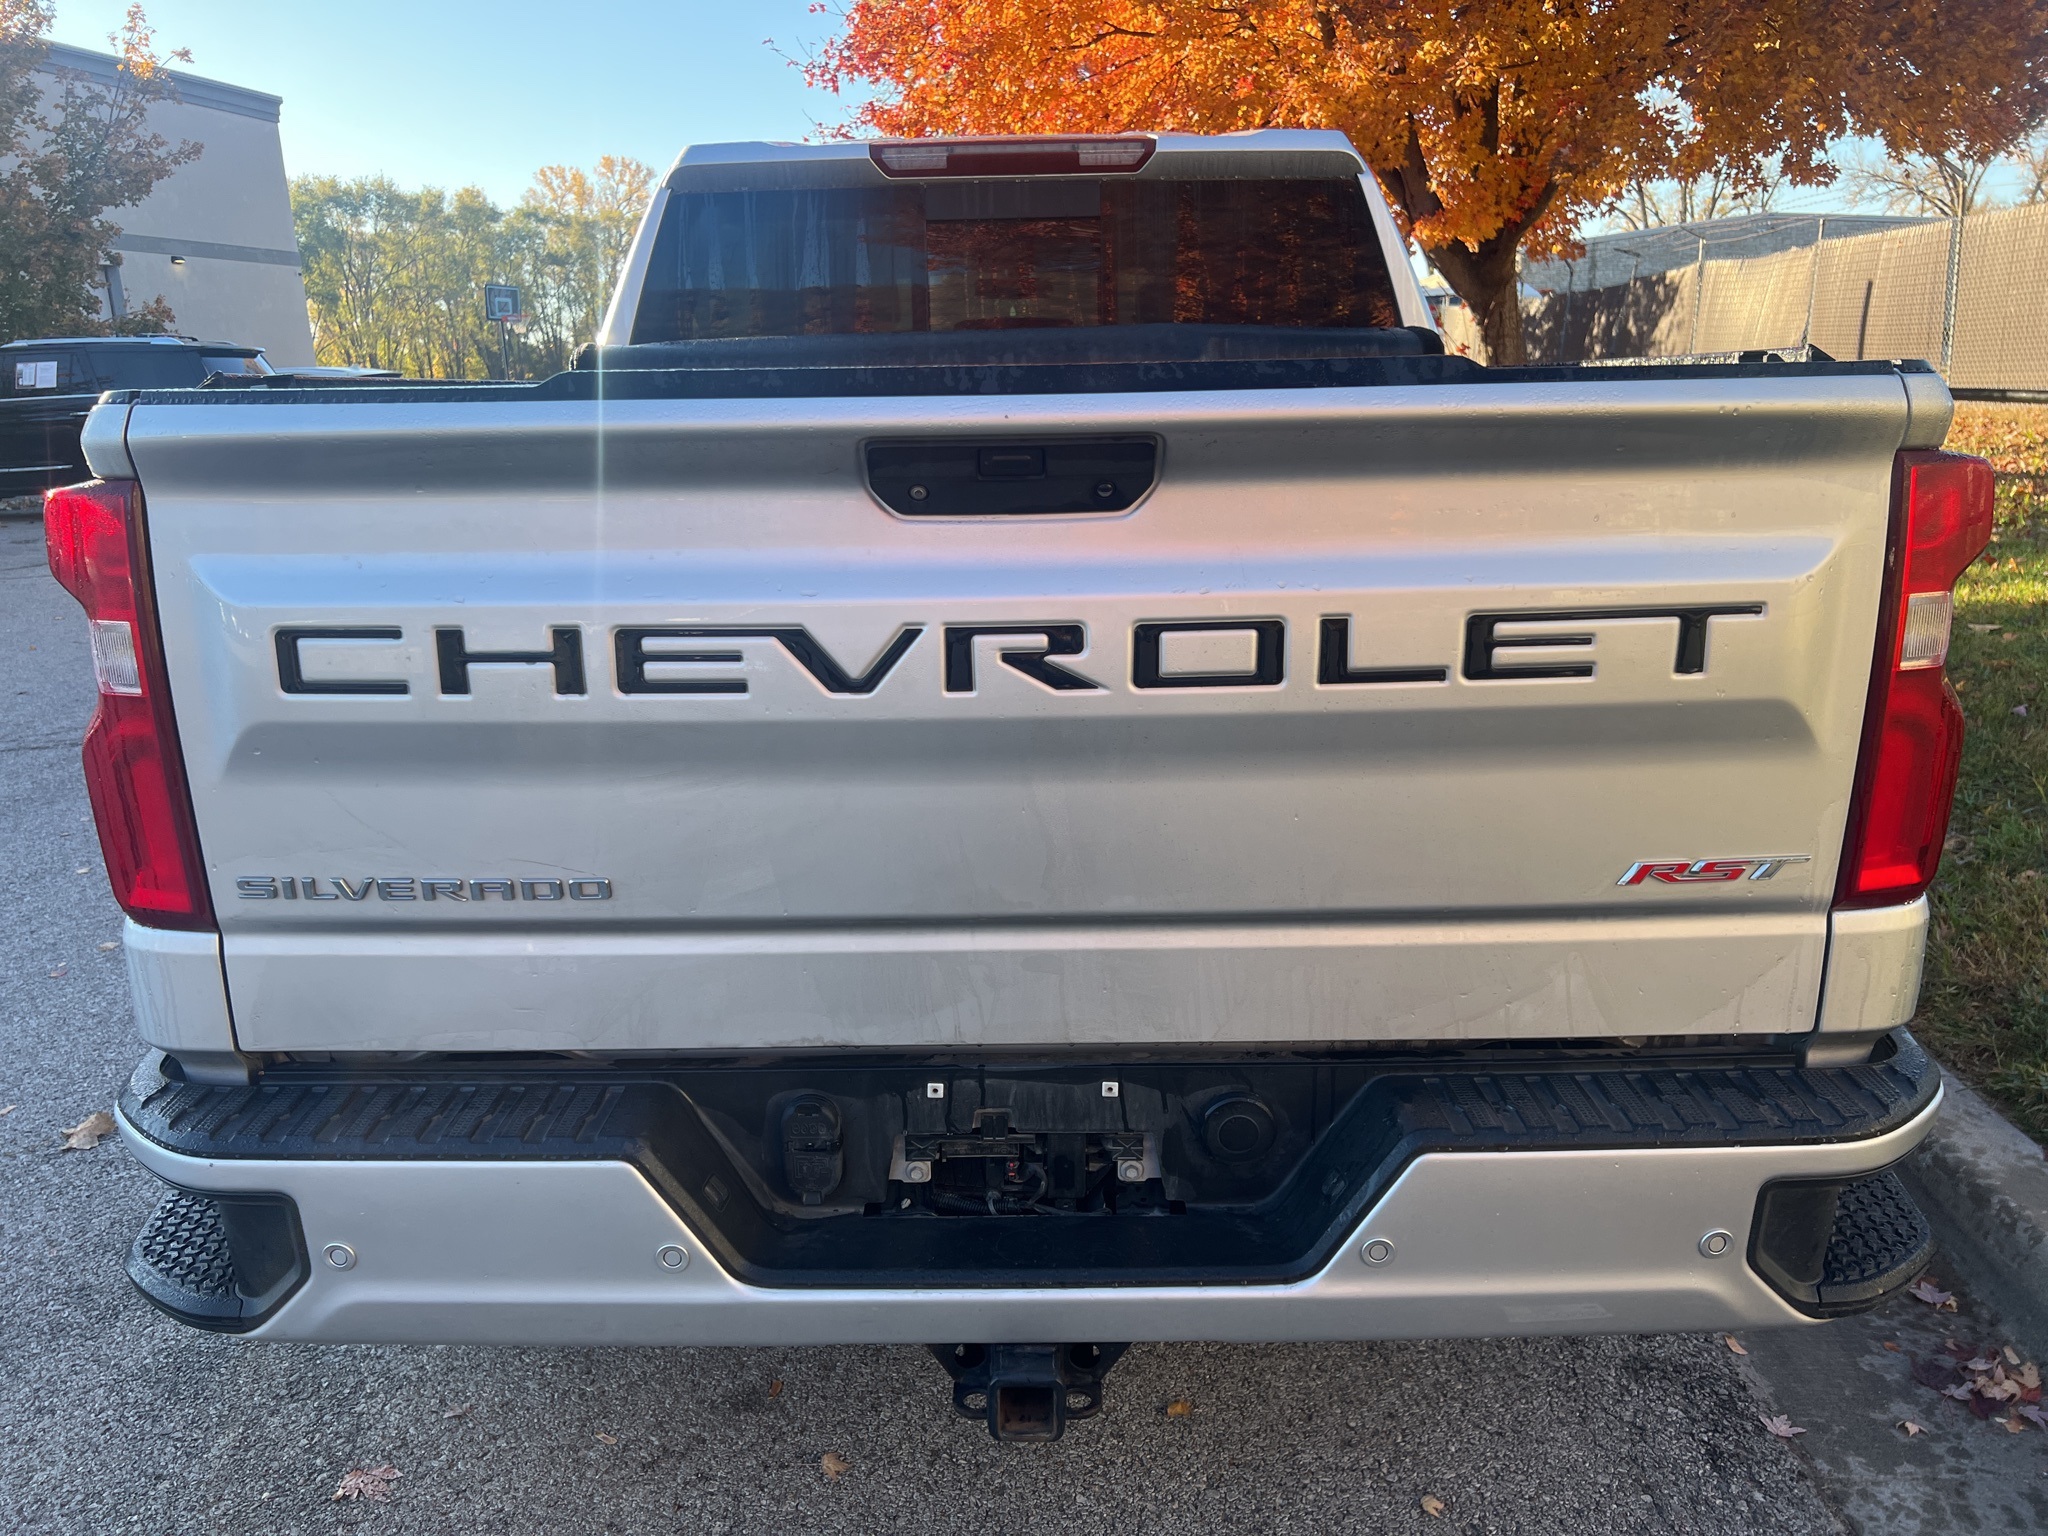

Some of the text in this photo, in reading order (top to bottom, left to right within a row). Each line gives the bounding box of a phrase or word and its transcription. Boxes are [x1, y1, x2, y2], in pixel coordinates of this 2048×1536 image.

[274, 604, 1764, 696] CHEVROLET
[1615, 854, 1812, 886] RST
[236, 875, 613, 902] SILVERADO
